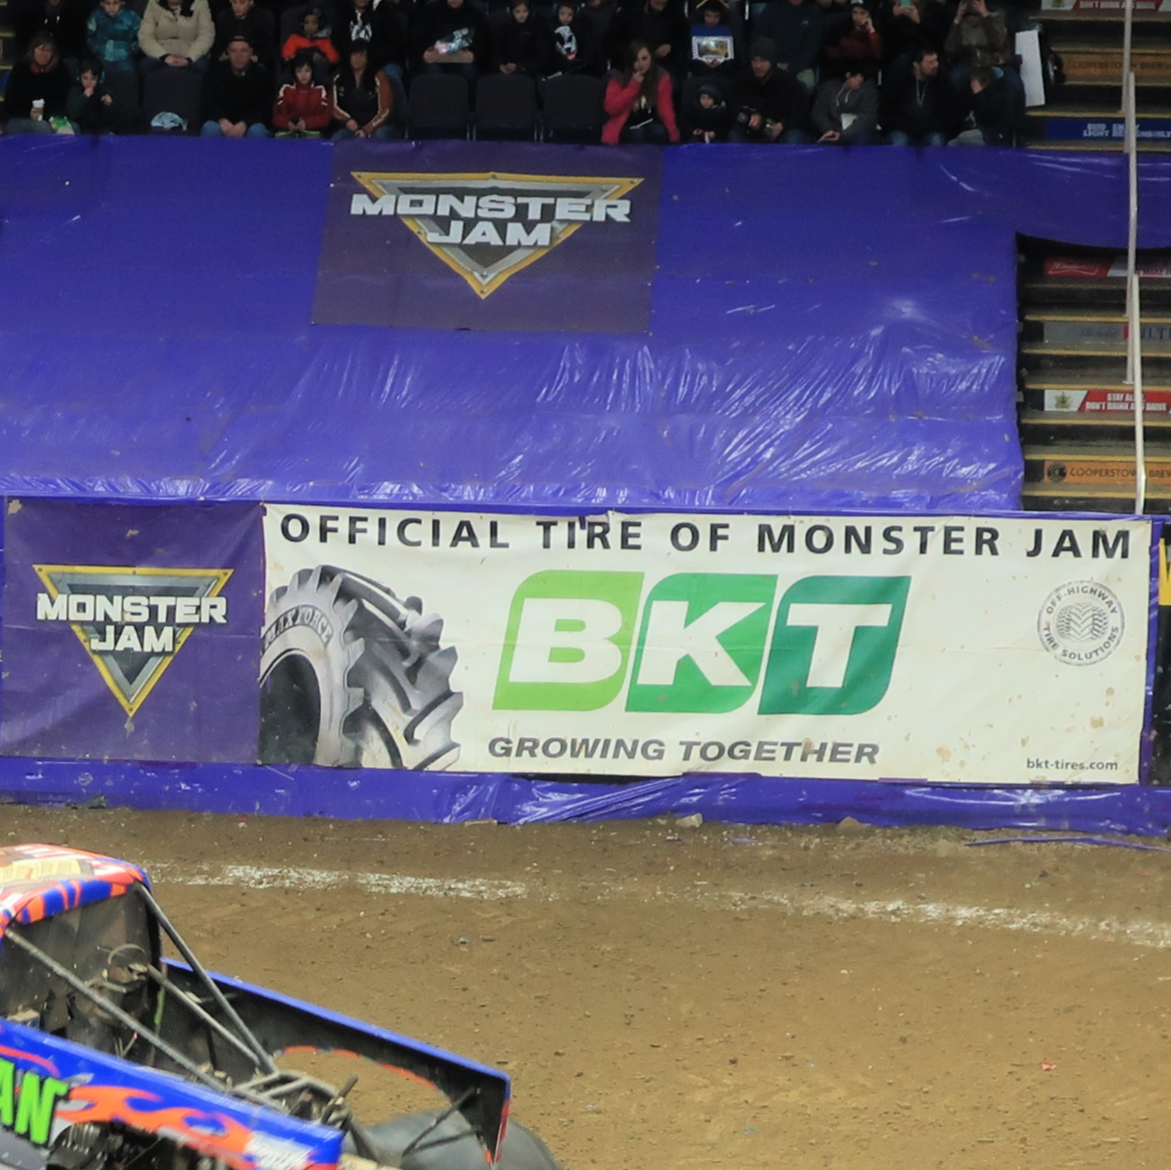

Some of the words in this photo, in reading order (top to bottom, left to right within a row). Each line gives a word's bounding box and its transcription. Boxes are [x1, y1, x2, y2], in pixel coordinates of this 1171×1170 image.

[350, 194, 631, 222] MONSTER
[427, 220, 552, 246] JAM
[280, 513, 510, 549] OFFICIAL
[536, 520, 643, 551] TIRE
[669, 522, 730, 552] OF
[757, 524, 1000, 556] MONSTER
[1026, 528, 1130, 559] JAM
[36, 593, 227, 623] MONSTER
[1046, 585, 1119, 615] OFF-HIGHWAY
[90, 625, 174, 652] JAM
[509, 597, 893, 688] BKT
[1043, 626, 1059, 650] TIRE
[1061, 625, 1120, 661] SOLUTIONS
[488, 736, 666, 760] GROWING
[679, 740, 880, 764] TOGETHER
[1026, 757, 1119, 771] bkt-tires.com
